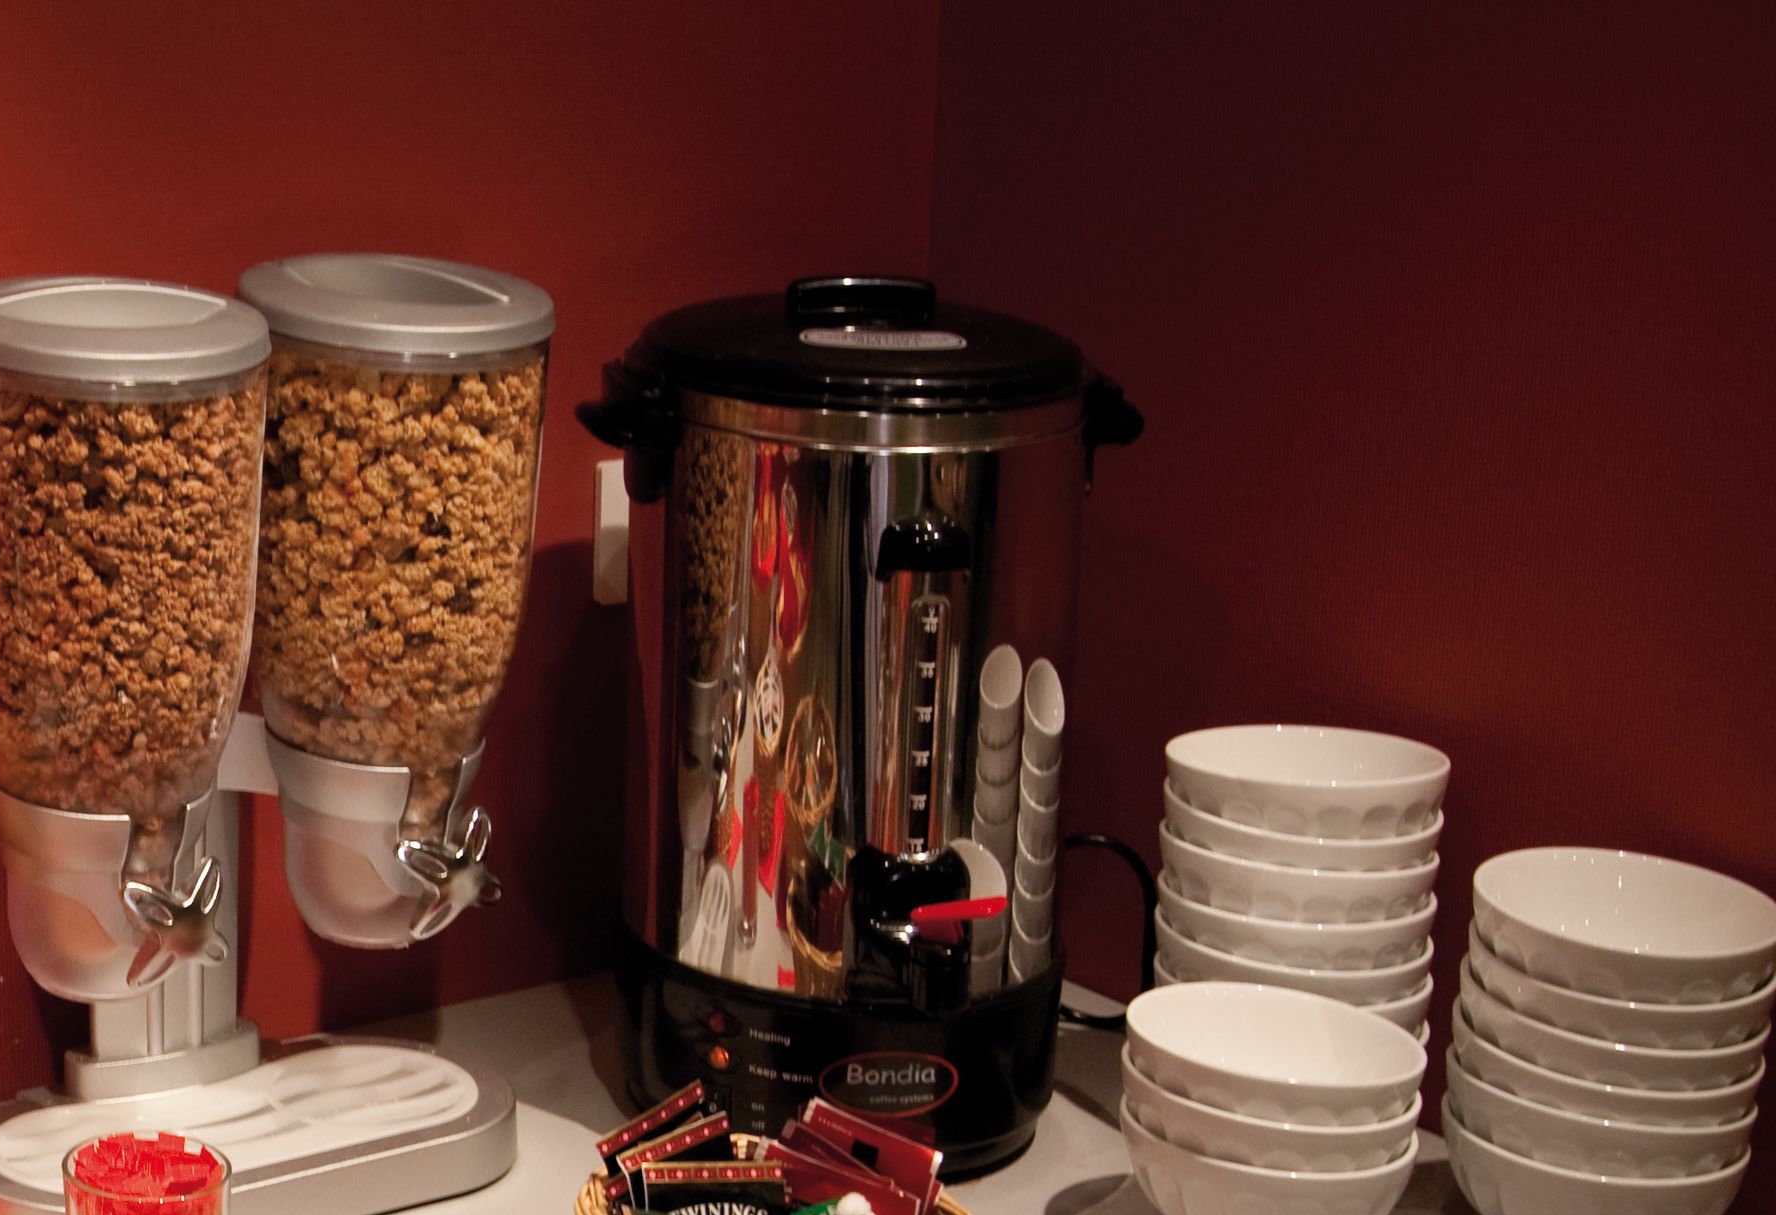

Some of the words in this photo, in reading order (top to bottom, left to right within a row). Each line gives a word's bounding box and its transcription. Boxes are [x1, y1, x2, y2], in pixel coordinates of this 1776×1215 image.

[749, 1064, 777, 1082] Keep
[782, 1072, 813, 1085] warm
[846, 1063, 936, 1087] Bondia
